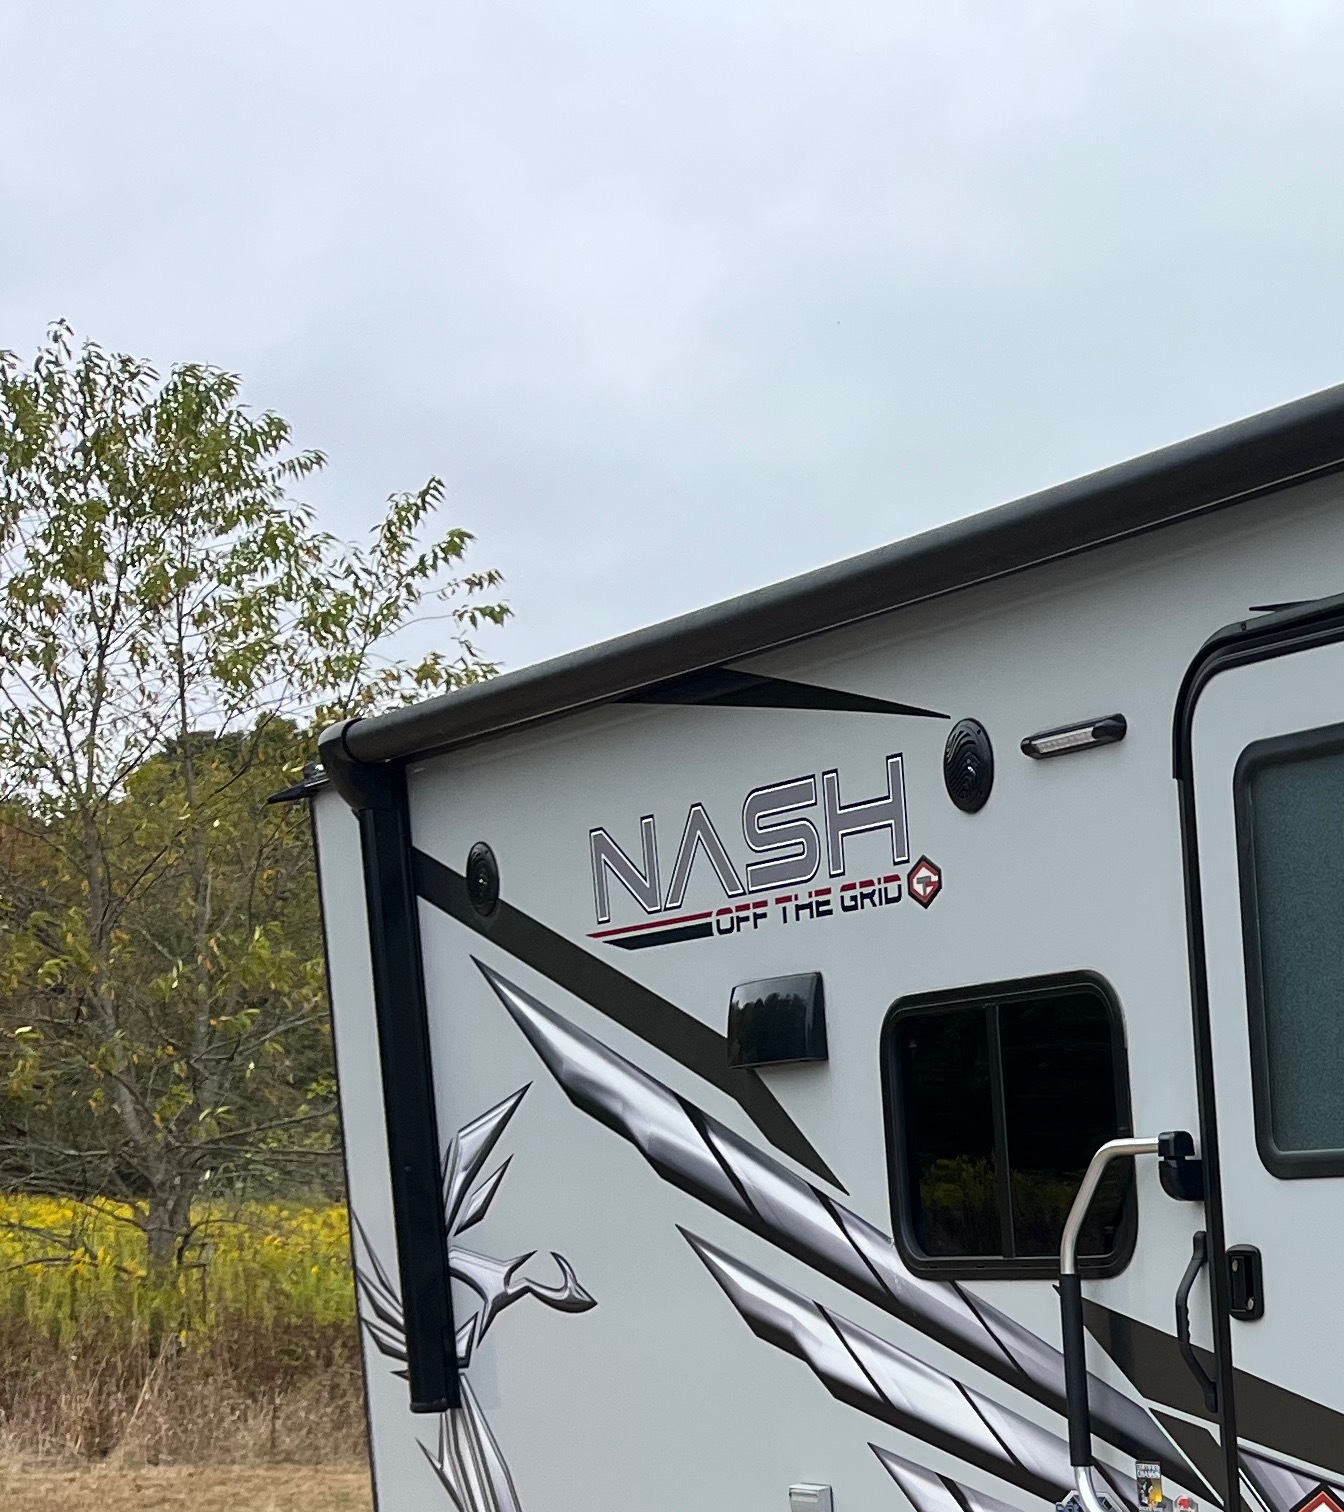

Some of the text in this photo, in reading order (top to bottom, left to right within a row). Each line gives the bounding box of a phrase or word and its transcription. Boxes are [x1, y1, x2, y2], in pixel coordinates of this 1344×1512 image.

[589, 752, 910, 925] NASH
[715, 873, 902, 936] OFF THE GRID
